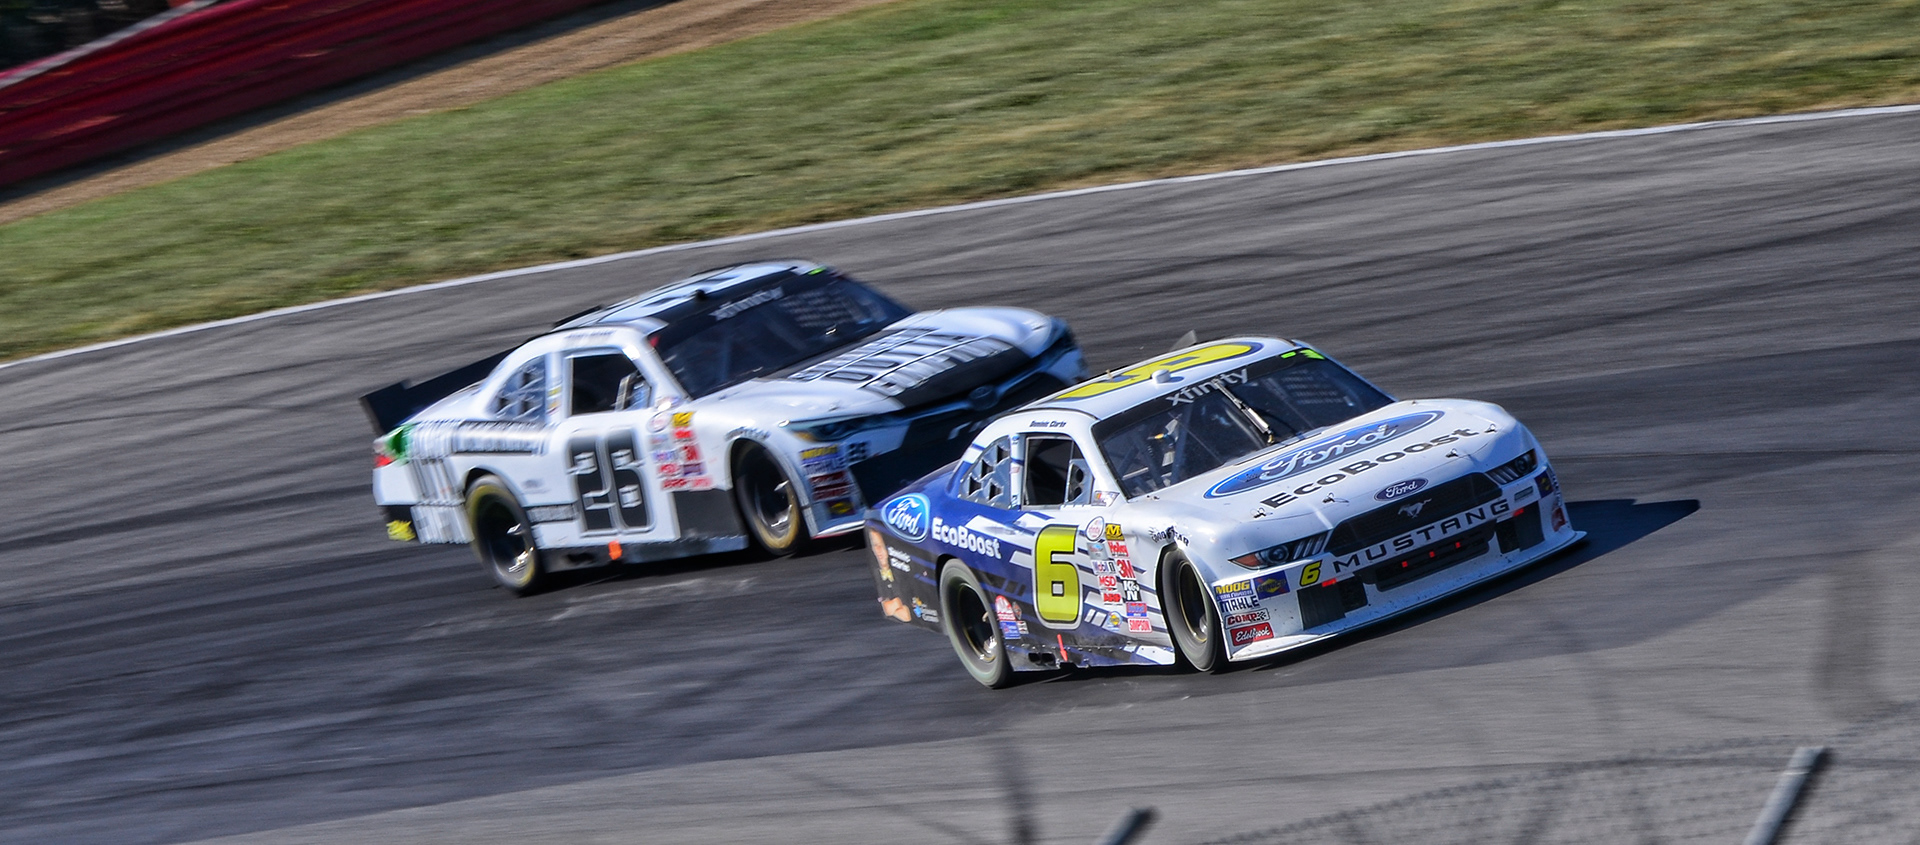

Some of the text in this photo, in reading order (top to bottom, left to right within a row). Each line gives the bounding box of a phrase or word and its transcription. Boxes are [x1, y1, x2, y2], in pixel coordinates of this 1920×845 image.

[1260, 423, 1398, 481] Ford
[1260, 427, 1479, 509] EcoBoost
[563, 428, 656, 537] 26
[1385, 479, 1417, 499] Ford
[887, 497, 922, 536] Ford
[1334, 498, 1510, 574] MUSTANG
[931, 516, 1002, 560] EcoBoost
[1034, 523, 1081, 625] 6
[1117, 559, 1136, 579] 3M
[1215, 581, 1251, 594] MOOG
[1300, 561, 1322, 587] 6
[1219, 595, 1260, 613] MAHLE
